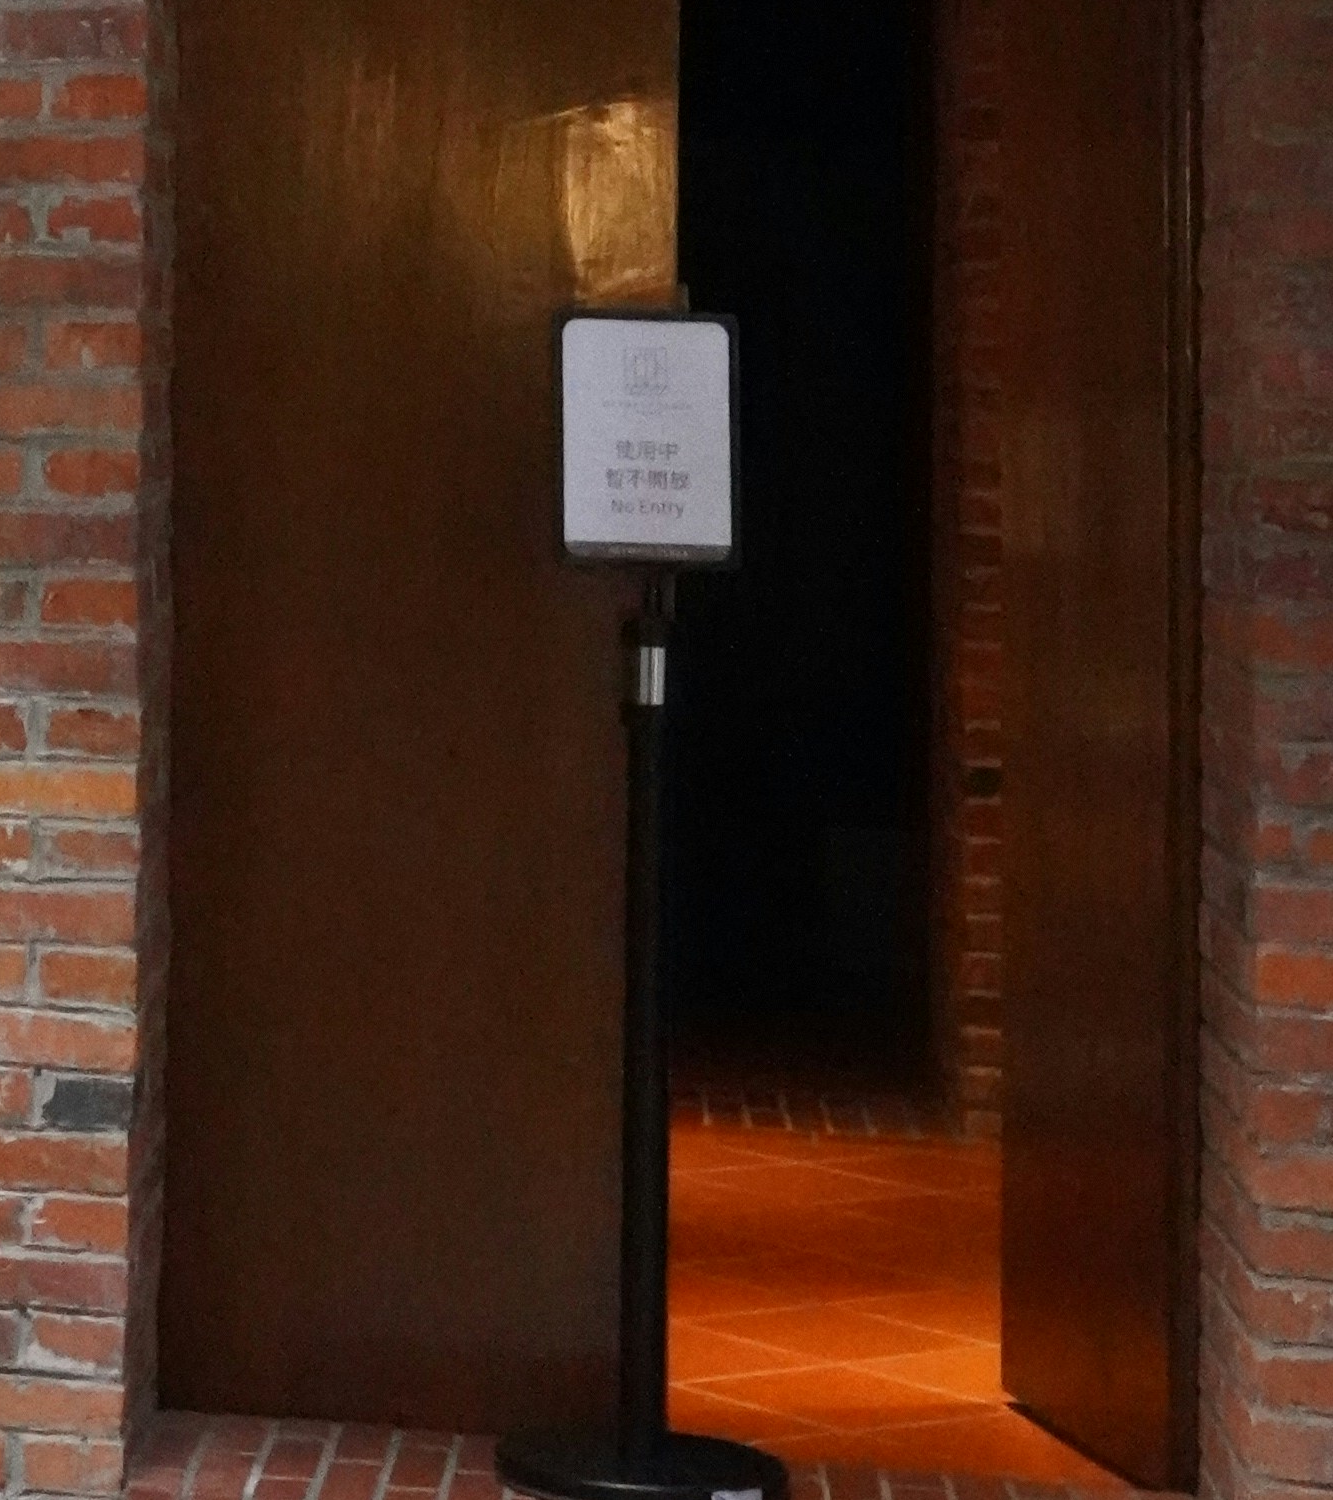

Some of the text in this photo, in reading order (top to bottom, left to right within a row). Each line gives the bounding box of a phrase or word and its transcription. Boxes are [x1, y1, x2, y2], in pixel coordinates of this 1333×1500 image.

[606, 468, 690, 490] 暫不開放
[611, 499, 684, 519] No Entry
